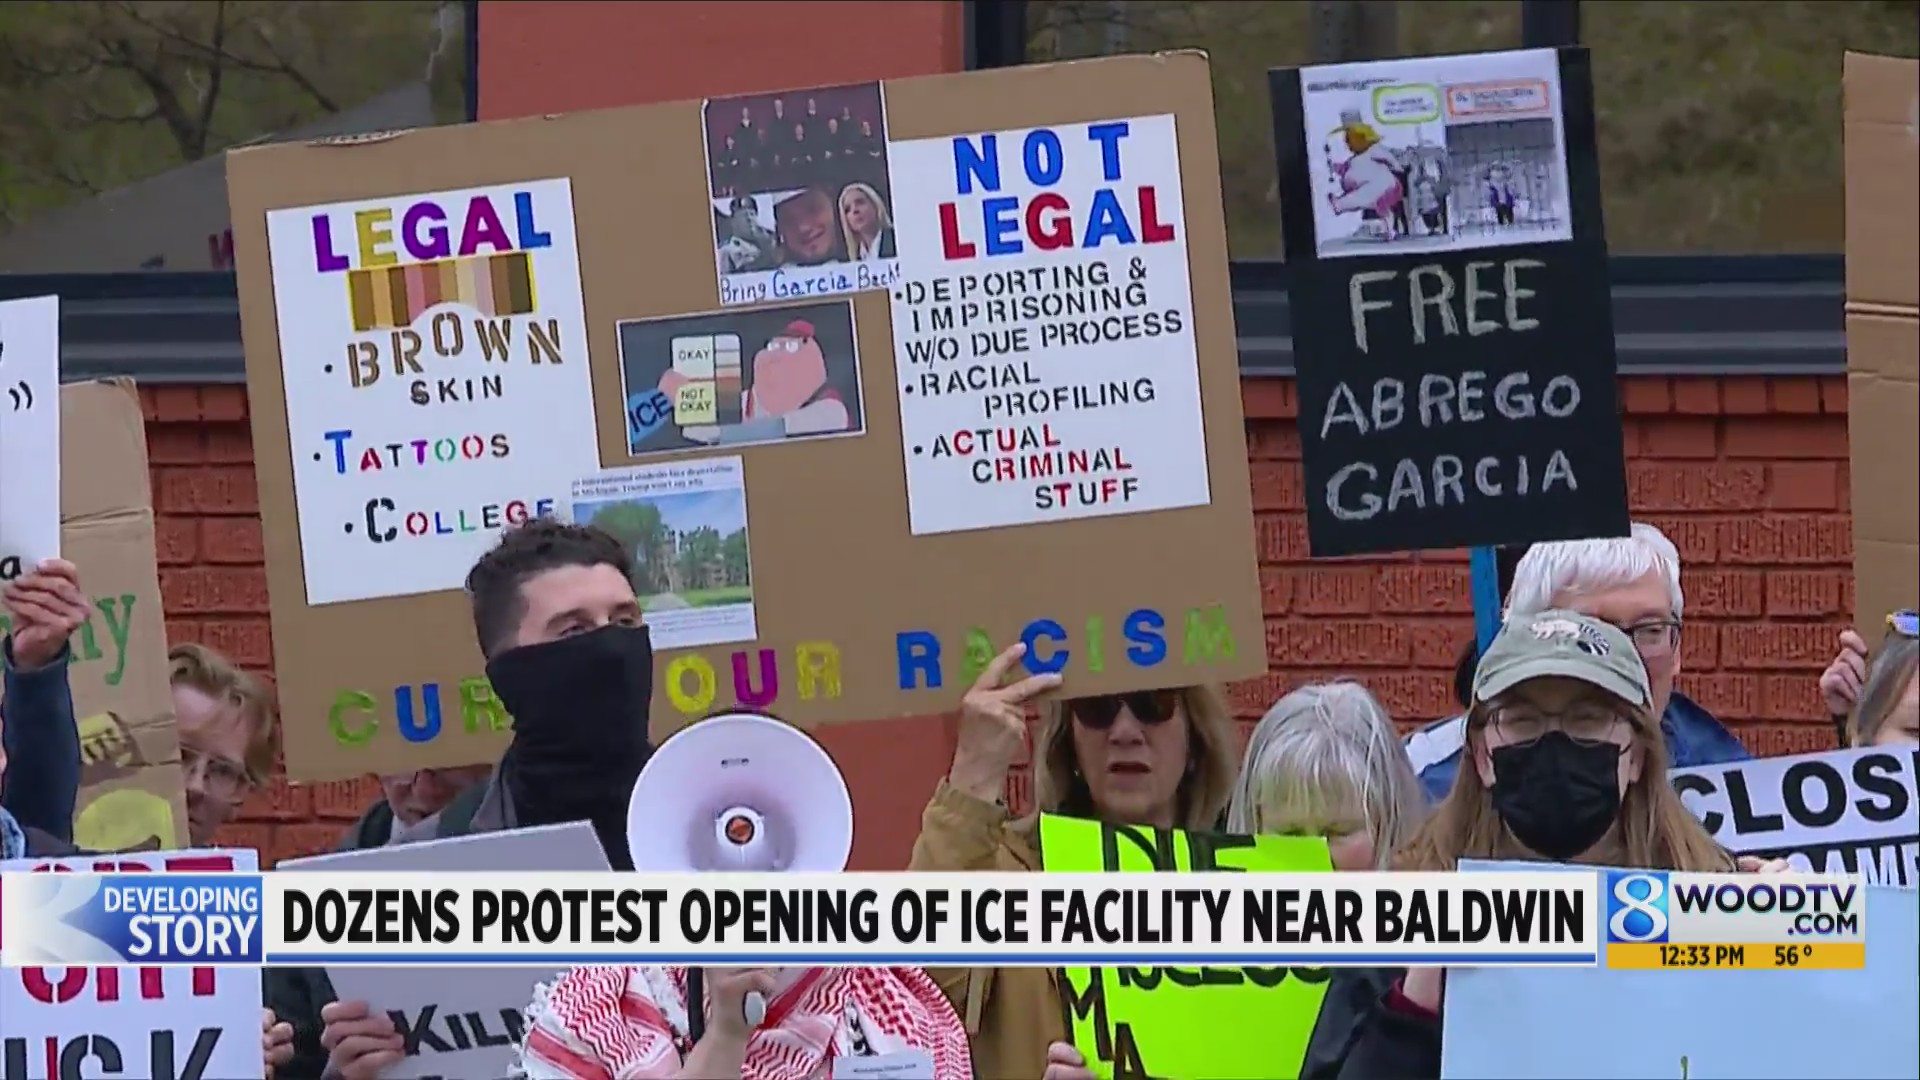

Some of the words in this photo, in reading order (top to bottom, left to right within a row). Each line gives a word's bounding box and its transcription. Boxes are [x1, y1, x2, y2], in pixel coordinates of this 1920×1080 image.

[952, 122, 1129, 195] NOT
[312, 191, 552, 273] LEGAL
[939, 186, 1176, 261] LEGAL
[721, 279, 766, 304] Bring
[773, 269, 853, 297] Garcia
[905, 261, 1110, 305] DEPORTING
[1129, 256, 1148, 281] &
[912, 283, 1148, 333] IMPRISONING
[1349, 259, 1546, 354] FREE
[346, 312, 564, 388] BROWN
[679, 349, 710, 361] OKAY
[906, 334, 959, 369] W/O
[972, 328, 1030, 359] DUE
[1041, 309, 1183, 349] PROCESS
[410, 375, 504, 406] SKIN
[681, 389, 705, 400] NOT
[921, 362, 1041, 397] RACIAL
[985, 378, 1156, 419] PROFILING
[629, 392, 672, 432] ICE
[680, 400, 712, 412] OKAY
[1320, 371, 1581, 440] ABREGO
[324, 430, 510, 474] TATTOOS
[932, 424, 1061, 458] ACTUAL
[973, 447, 1132, 484] CRIMINAL
[1326, 450, 1577, 520] GARCIA
[1035, 478, 1138, 510] STUFF
[665, 642, 841, 715] OUR
[896, 605, 1236, 690] RACISM
[1674, 750, 1919, 836] CLOS
